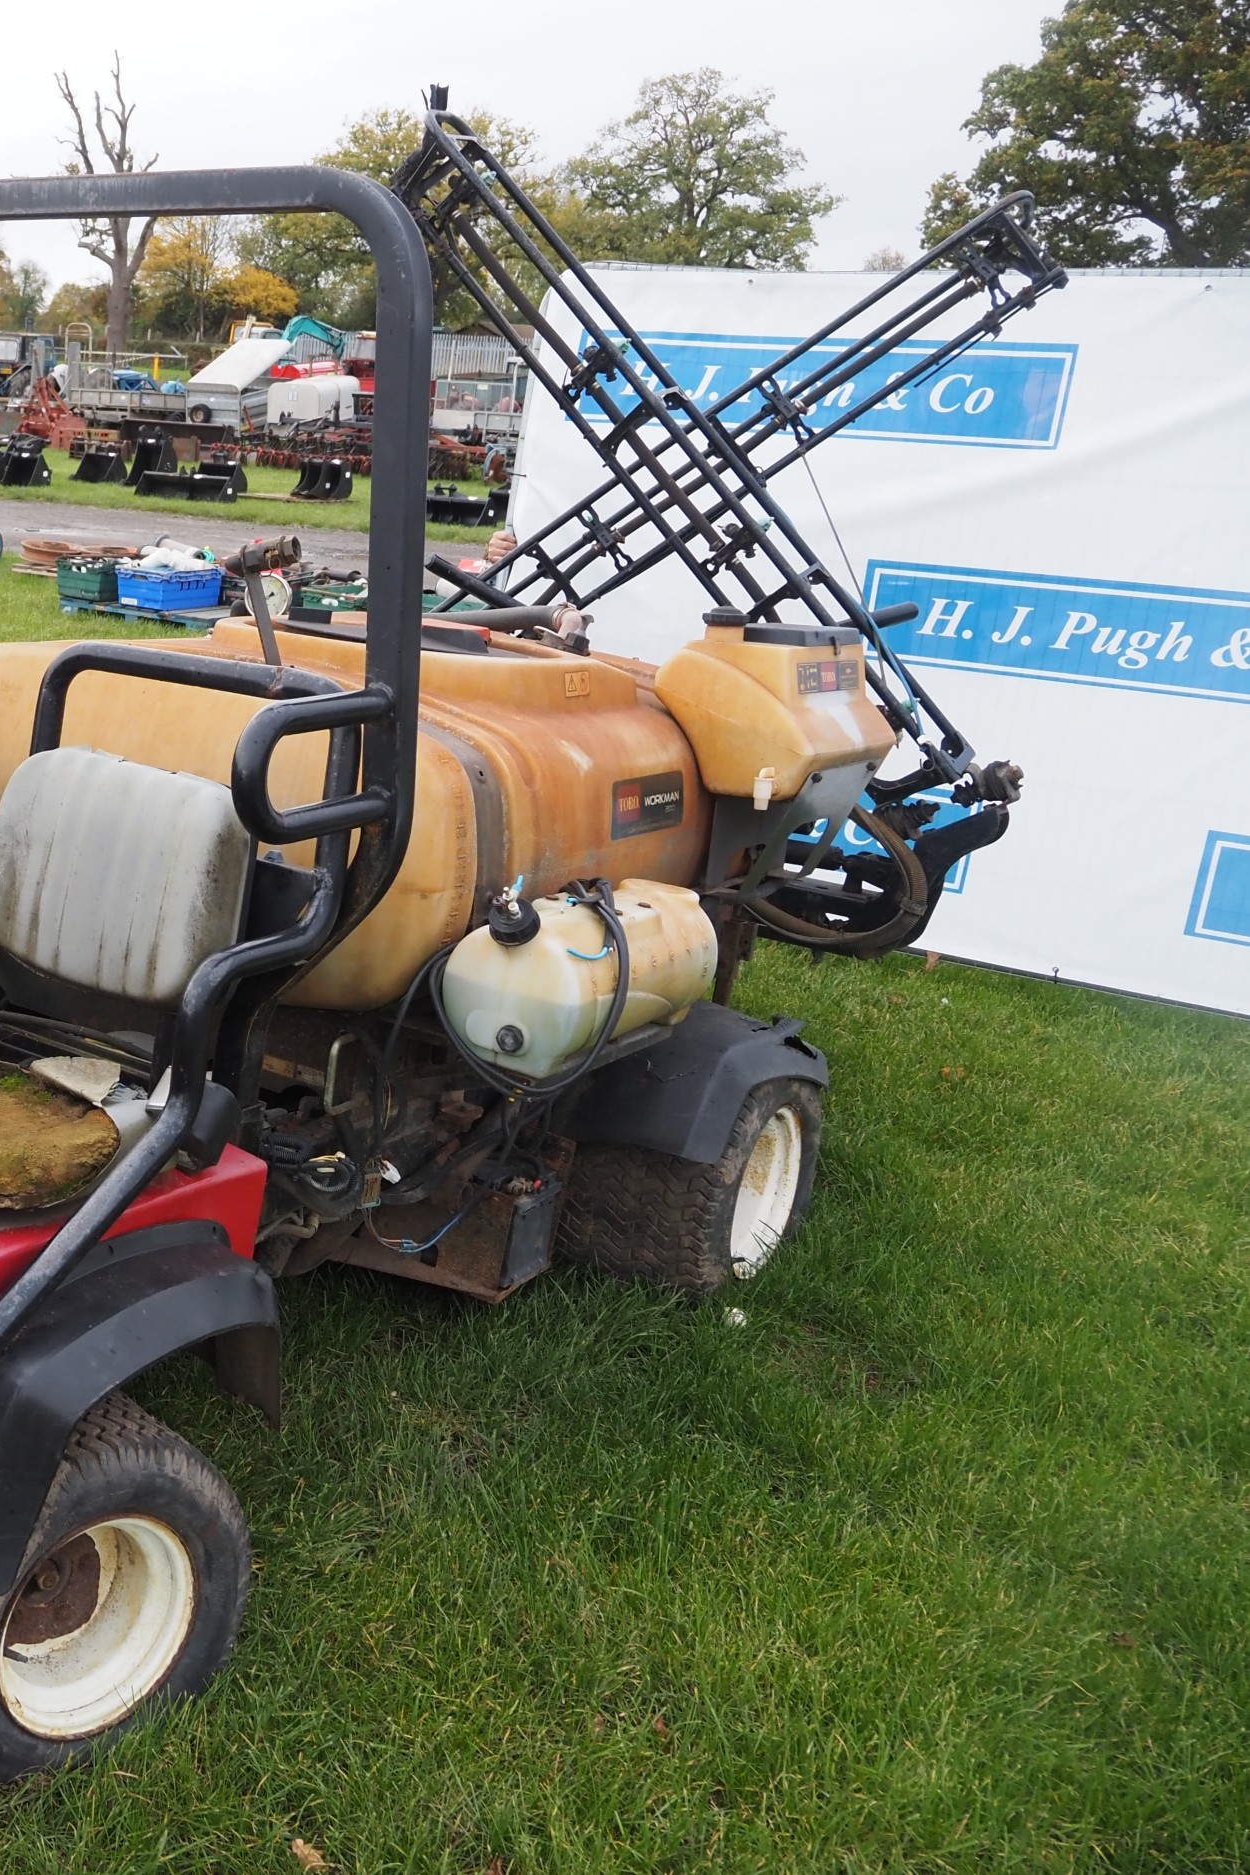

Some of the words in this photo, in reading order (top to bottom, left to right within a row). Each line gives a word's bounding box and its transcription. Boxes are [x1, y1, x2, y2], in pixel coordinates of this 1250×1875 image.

[619, 360, 672, 397] H
[929, 373, 995, 415] Co
[916, 597, 974, 640] H.
[991, 605, 1035, 646] J.
[1048, 610, 1193, 670] Pugh
[1209, 627, 1250, 670] &
[618, 795, 640, 812] TORO
[644, 790, 680, 807] WORKMAN
